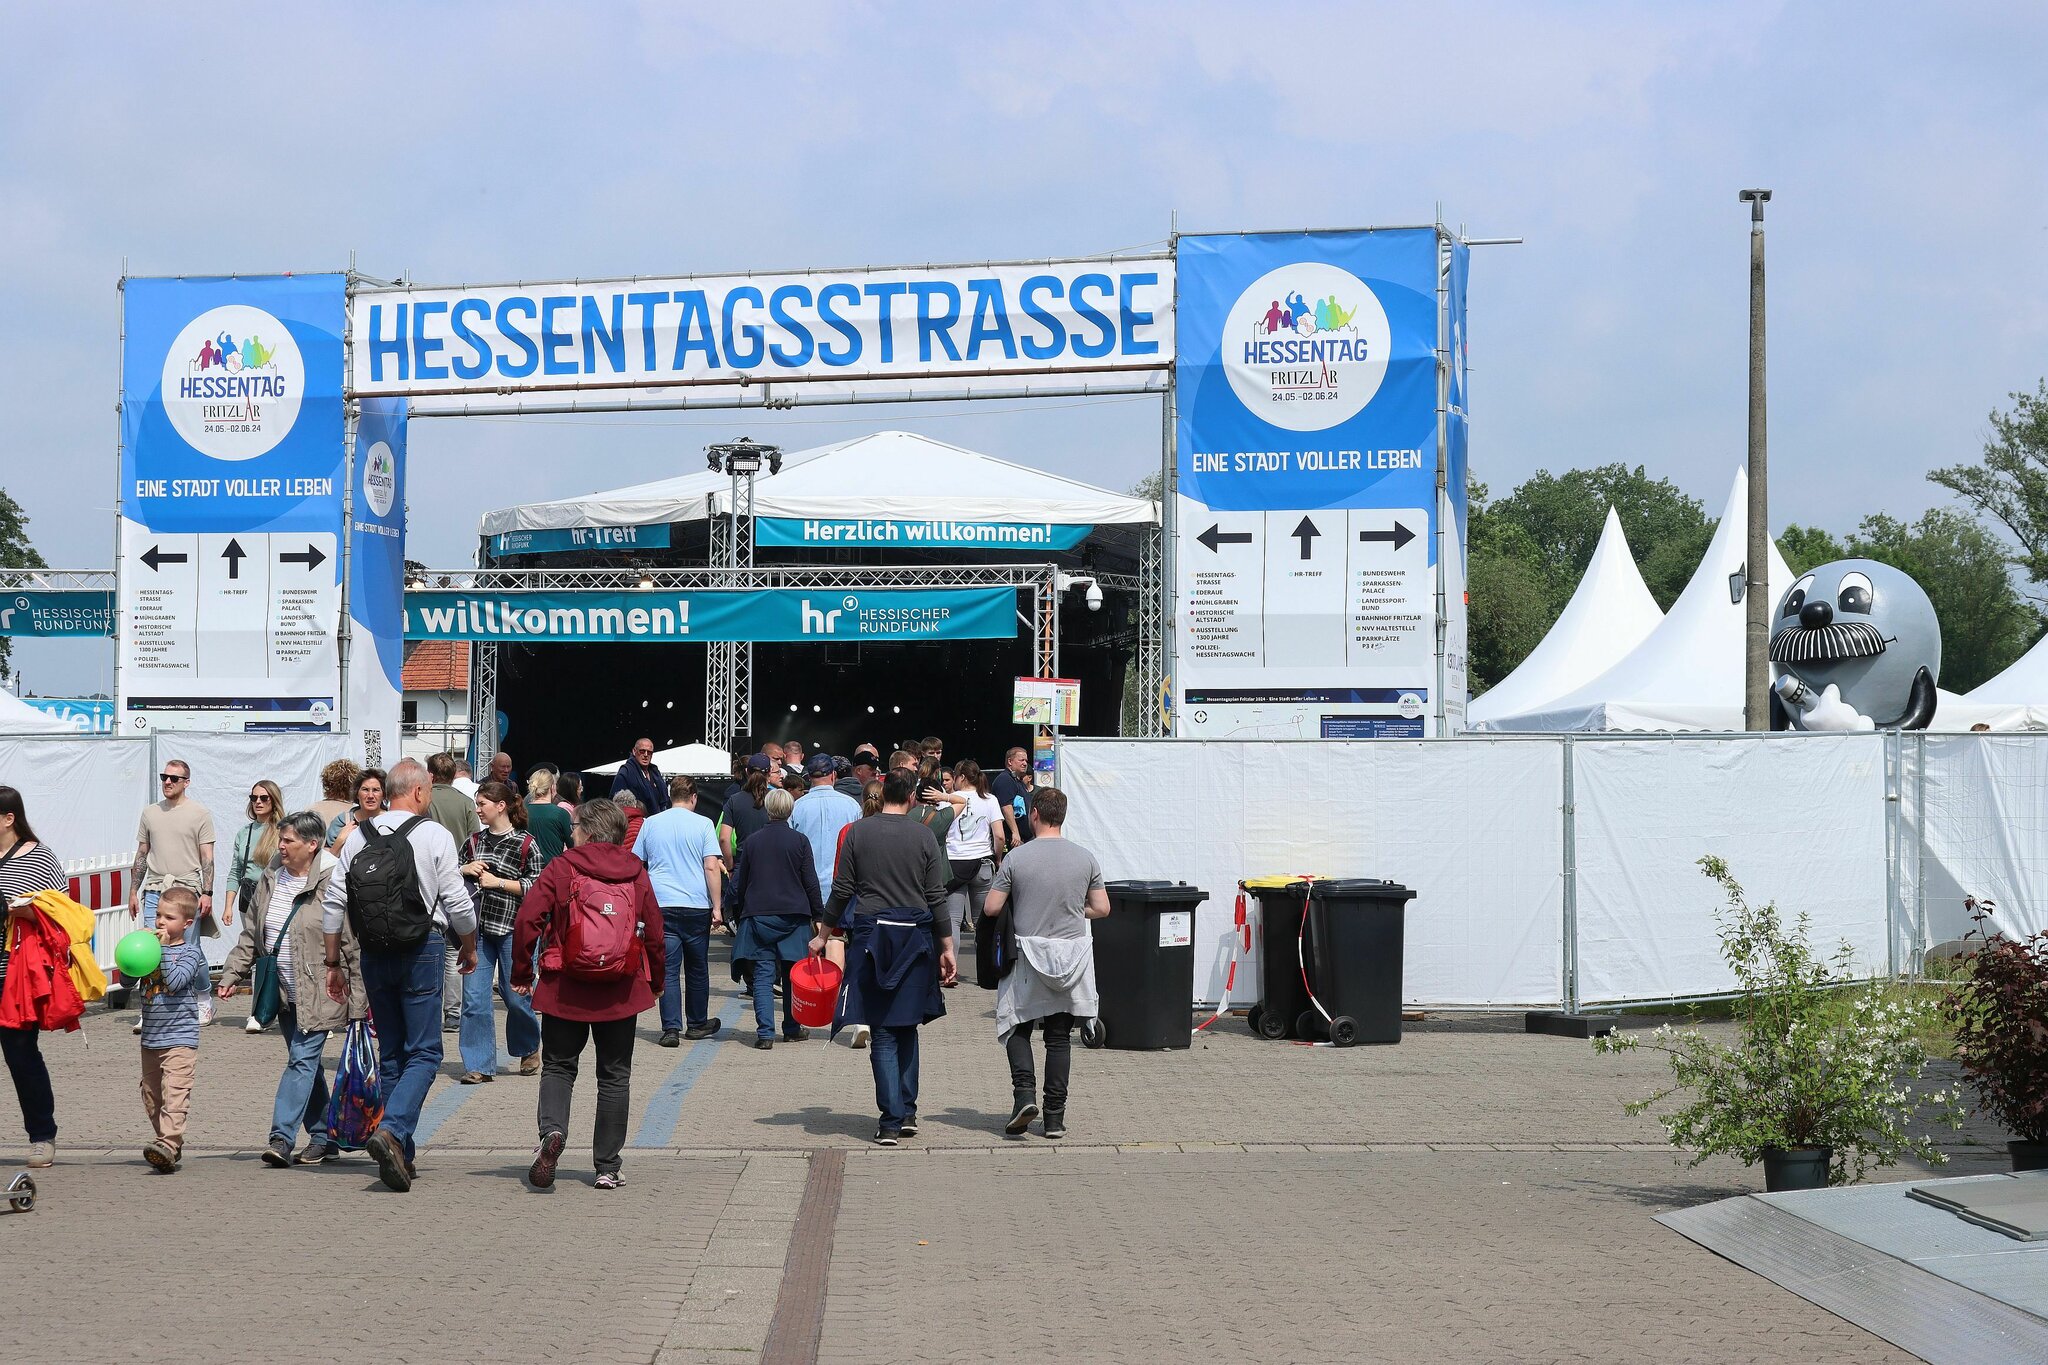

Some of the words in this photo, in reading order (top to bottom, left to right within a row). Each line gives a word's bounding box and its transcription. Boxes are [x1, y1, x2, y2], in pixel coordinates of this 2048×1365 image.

[369, 272, 1160, 383] HESSENTAGSSTRASSE
[1244, 339, 1367, 364] HESSENTAG
[1271, 362, 1337, 386] FRITZLAR
[180, 375, 285, 399] HESSENTAG
[1272, 391, 1338, 402] 24.05.-02.06.24
[203, 400, 260, 421] FRITZLAR
[204, 424, 261, 433] 24.05.-02.06.24
[1192, 453, 1229, 472] EINE
[1234, 451, 1291, 472] STADT
[1296, 450, 1361, 471] VOLLER
[1367, 449, 1422, 469] LEBEN
[136, 480, 167, 498] EINE
[172, 479, 220, 497] STADT
[225, 479, 280, 497] VOLLER
[285, 478, 332, 496] LEBEN
[804, 521, 899, 541] Herzlich
[905, 522, 1051, 543] willkommen!
[34, 620, 112, 631] RUNDFUNK
[420, 600, 690, 635] willkommen!
[801, 599, 842, 634] hr
[858, 608, 950, 621] HESSISCHER
[859, 621, 940, 633] RUNDFUNK
